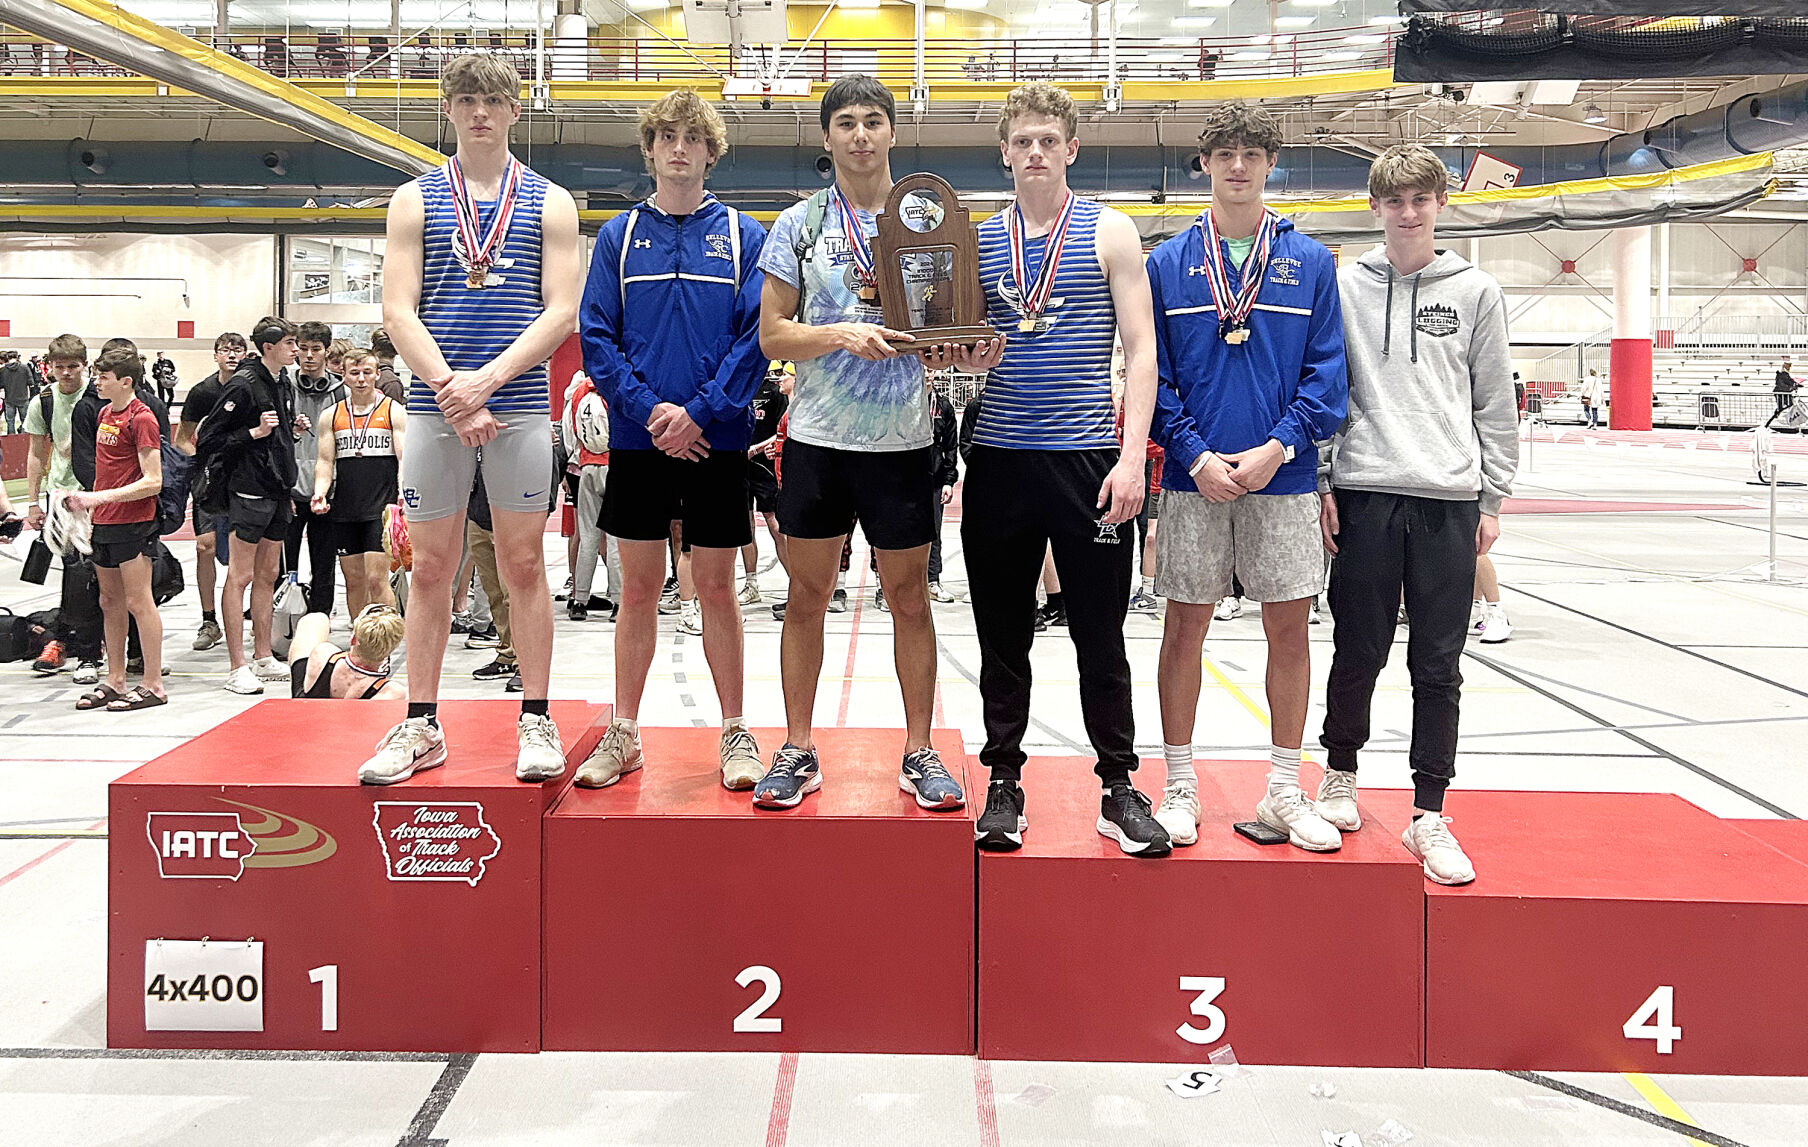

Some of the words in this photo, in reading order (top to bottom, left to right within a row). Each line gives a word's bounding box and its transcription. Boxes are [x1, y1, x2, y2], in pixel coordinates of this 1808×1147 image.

[1504, 173, 1516, 183] 3
[1417, 317, 1458, 325] LOGGING
[583, 403, 592, 417] 4
[413, 806, 459, 824] Iowa
[390, 822, 482, 841] Association
[162, 830, 240, 858] IATC
[399, 842, 412, 853] of
[413, 838, 460, 856] Track
[394, 856, 475, 875] Officials
[146, 973, 260, 1002] 4x400
[308, 964, 339, 1032] 1
[733, 965, 782, 1033] 2
[1175, 976, 1228, 1045] 3
[1621, 985, 1683, 1055] 4
[1182, 1070, 1214, 1091] 5
